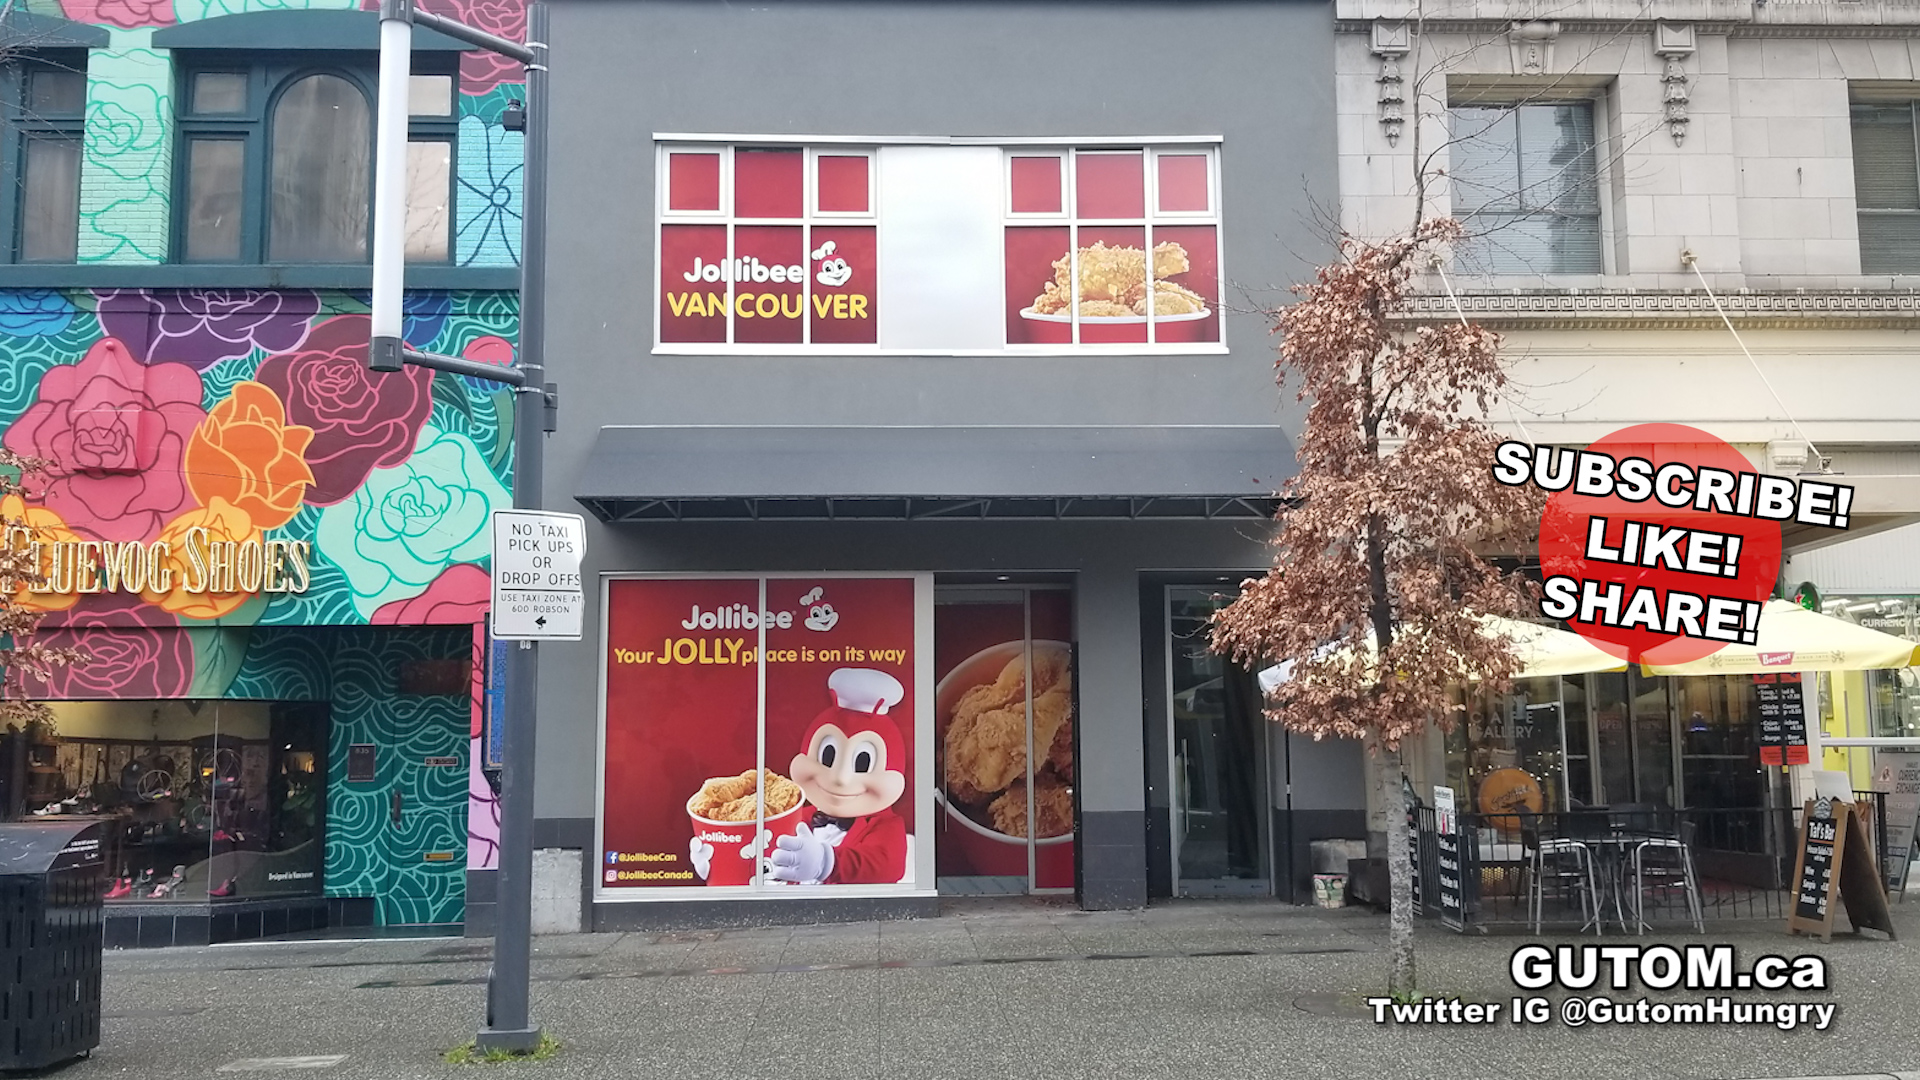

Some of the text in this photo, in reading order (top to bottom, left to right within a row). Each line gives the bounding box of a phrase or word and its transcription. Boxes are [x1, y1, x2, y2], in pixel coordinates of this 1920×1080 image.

[683, 256, 804, 283] Jollibee
[666, 292, 868, 319] VANCOUVER
[512, 523, 568, 538] NO TAXI
[509, 539, 573, 553] PICK UPS
[182, 526, 310, 594] SHOES
[532, 556, 552, 568] OR
[502, 572, 580, 586] DROP OFFS
[501, 594, 581, 603] USE TAXI ZONE AT
[512, 605, 530, 613] 600
[682, 603, 793, 630] Jollibee
[1861, 618, 1911, 628] CURRENCY
[614, 638, 906, 666] Your JOLLY place is on its way
[1762, 653, 1791, 665] Banquet
[699, 830, 742, 843] Jollibee
[1809, 822, 1835, 840] Taf's Bar
[618, 852, 677, 862] @JollibeeCan
[618, 870, 693, 880] @JollibeeCanada
